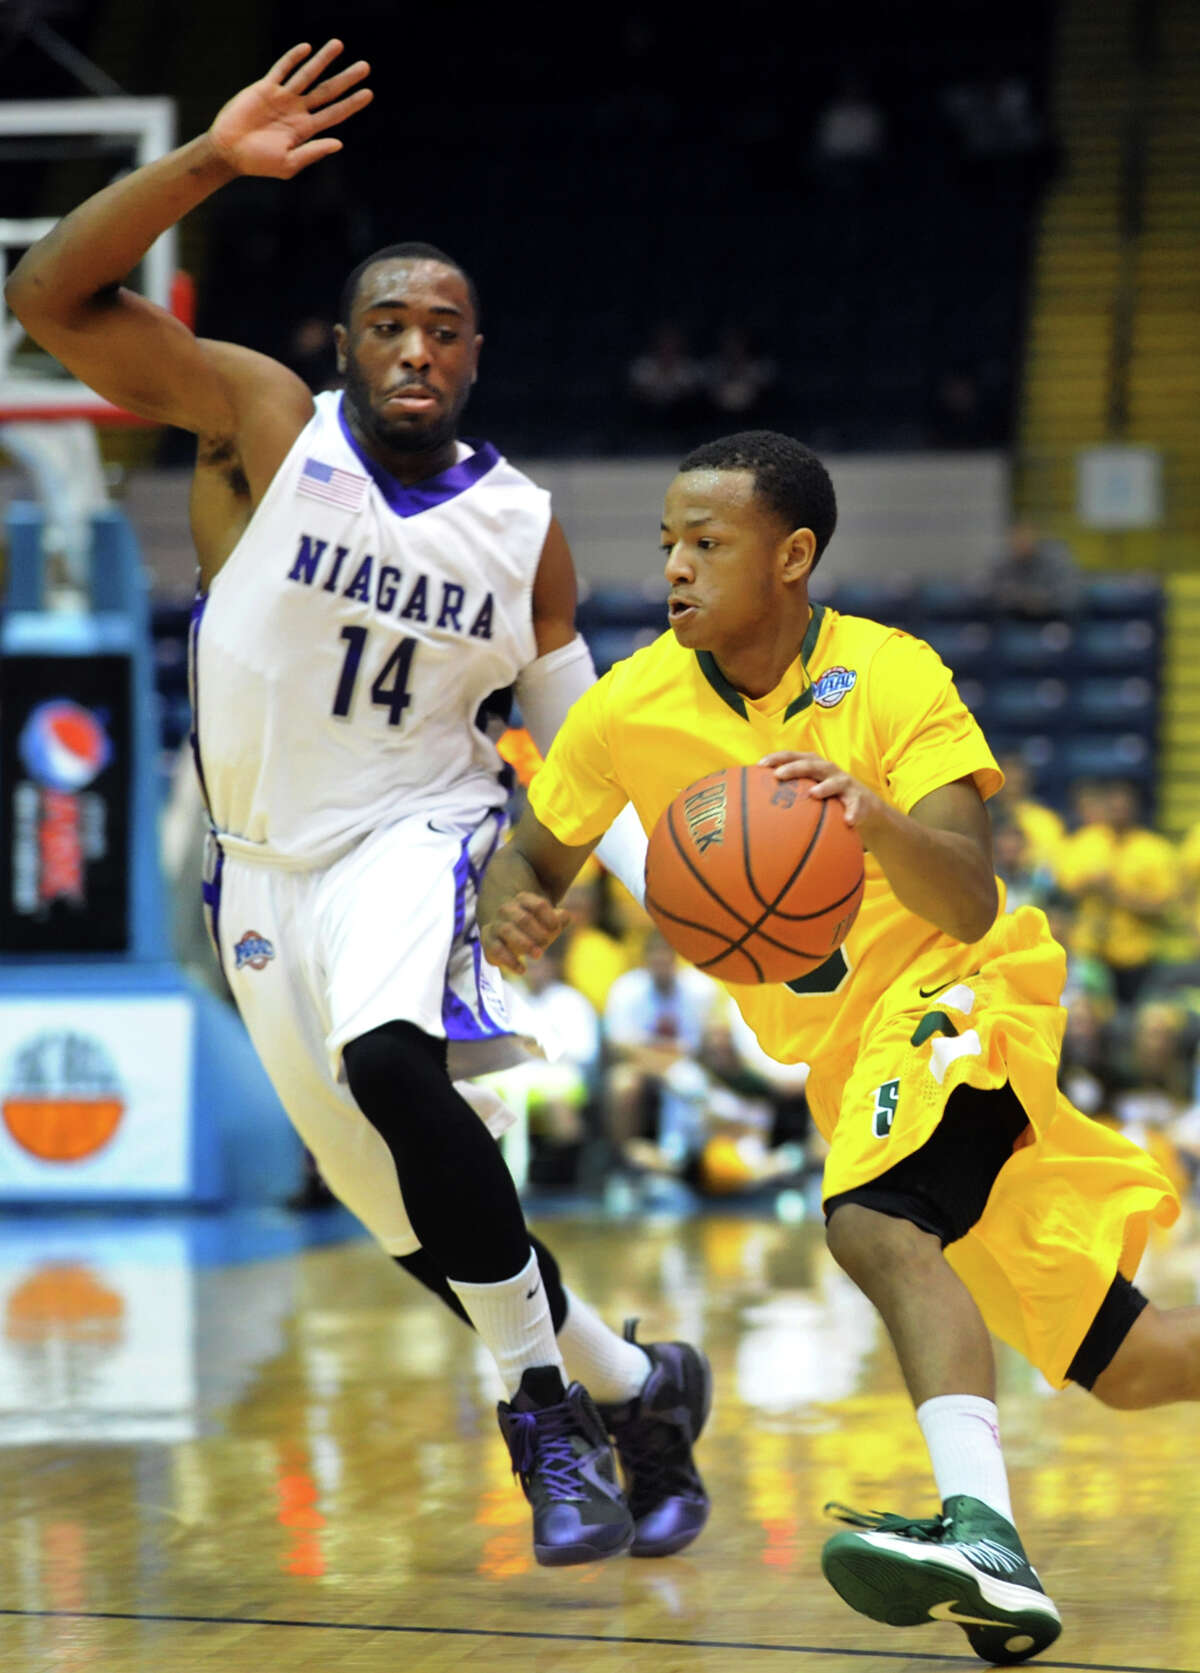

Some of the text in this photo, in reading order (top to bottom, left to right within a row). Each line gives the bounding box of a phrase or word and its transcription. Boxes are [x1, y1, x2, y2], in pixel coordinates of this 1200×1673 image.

[287, 534, 494, 639] NIAGARA
[332, 625, 418, 726] 14
[684, 781, 727, 854] ROCK
